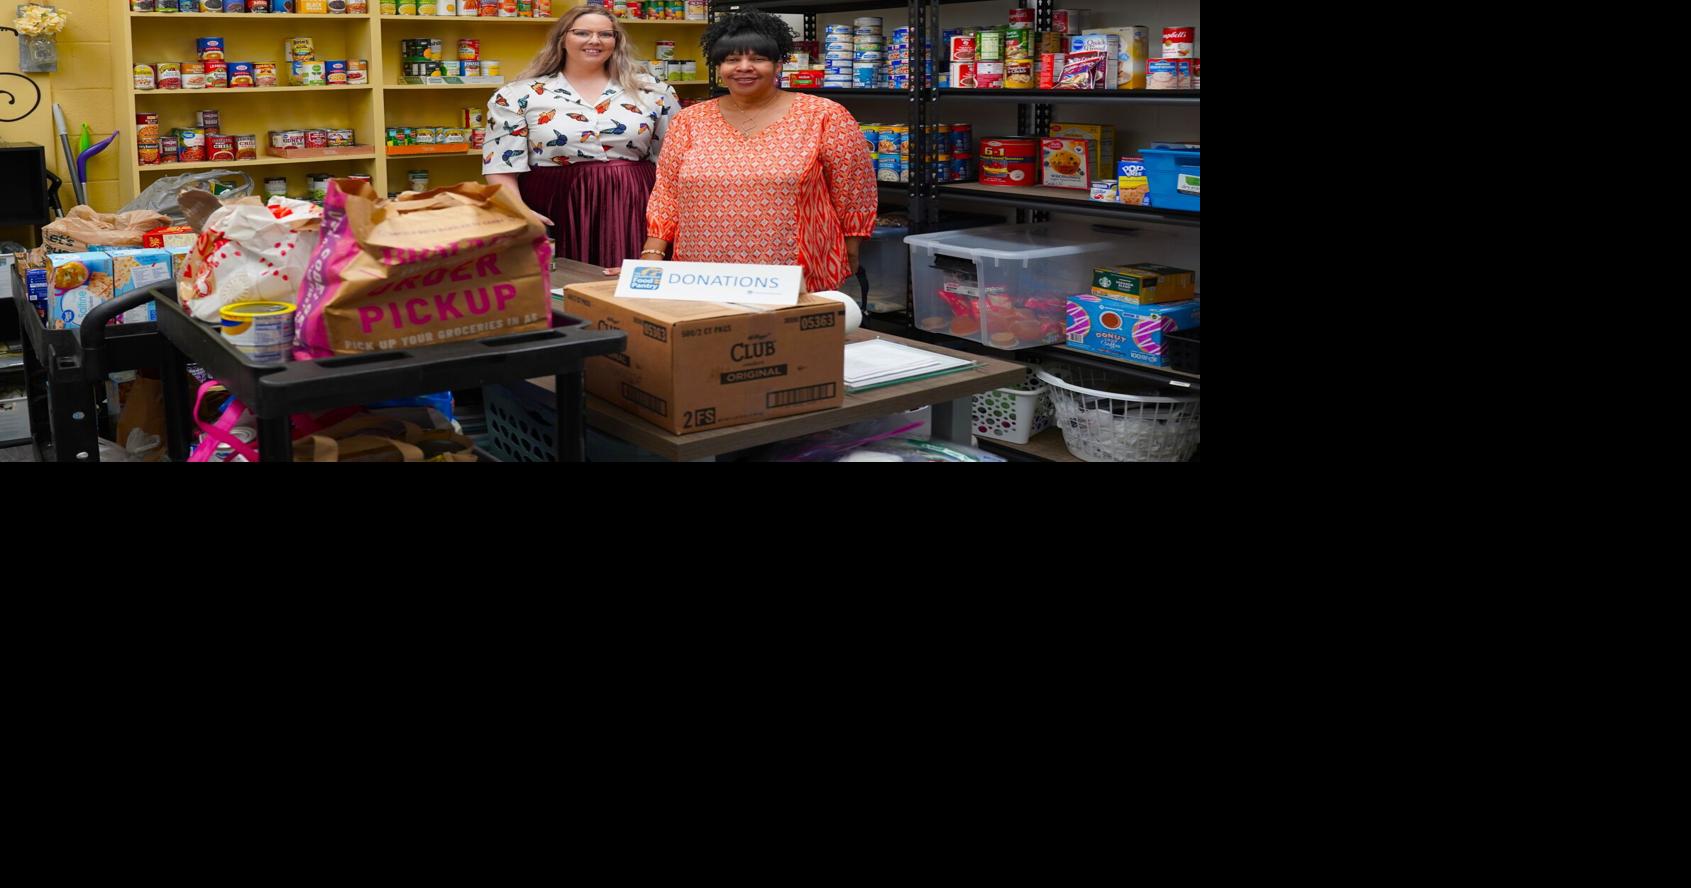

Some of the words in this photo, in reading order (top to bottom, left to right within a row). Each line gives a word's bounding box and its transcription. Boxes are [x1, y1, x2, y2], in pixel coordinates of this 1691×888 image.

[631, 282, 658, 290] Pantry
[668, 273, 779, 289] DONATIONS
[357, 283, 517, 334] PICKUP
[801, 313, 835, 330] 05363
[344, 339, 375, 350] PICK
[379, 340, 397, 350] UP
[401, 332, 433, 347] YOUR
[438, 319, 503, 339] GROCERIES
[507, 316, 520, 327] IN
[726, 366, 783, 383] ORIGINAL
[683, 411, 693, 429] 2
[697, 409, 715, 426] FS
